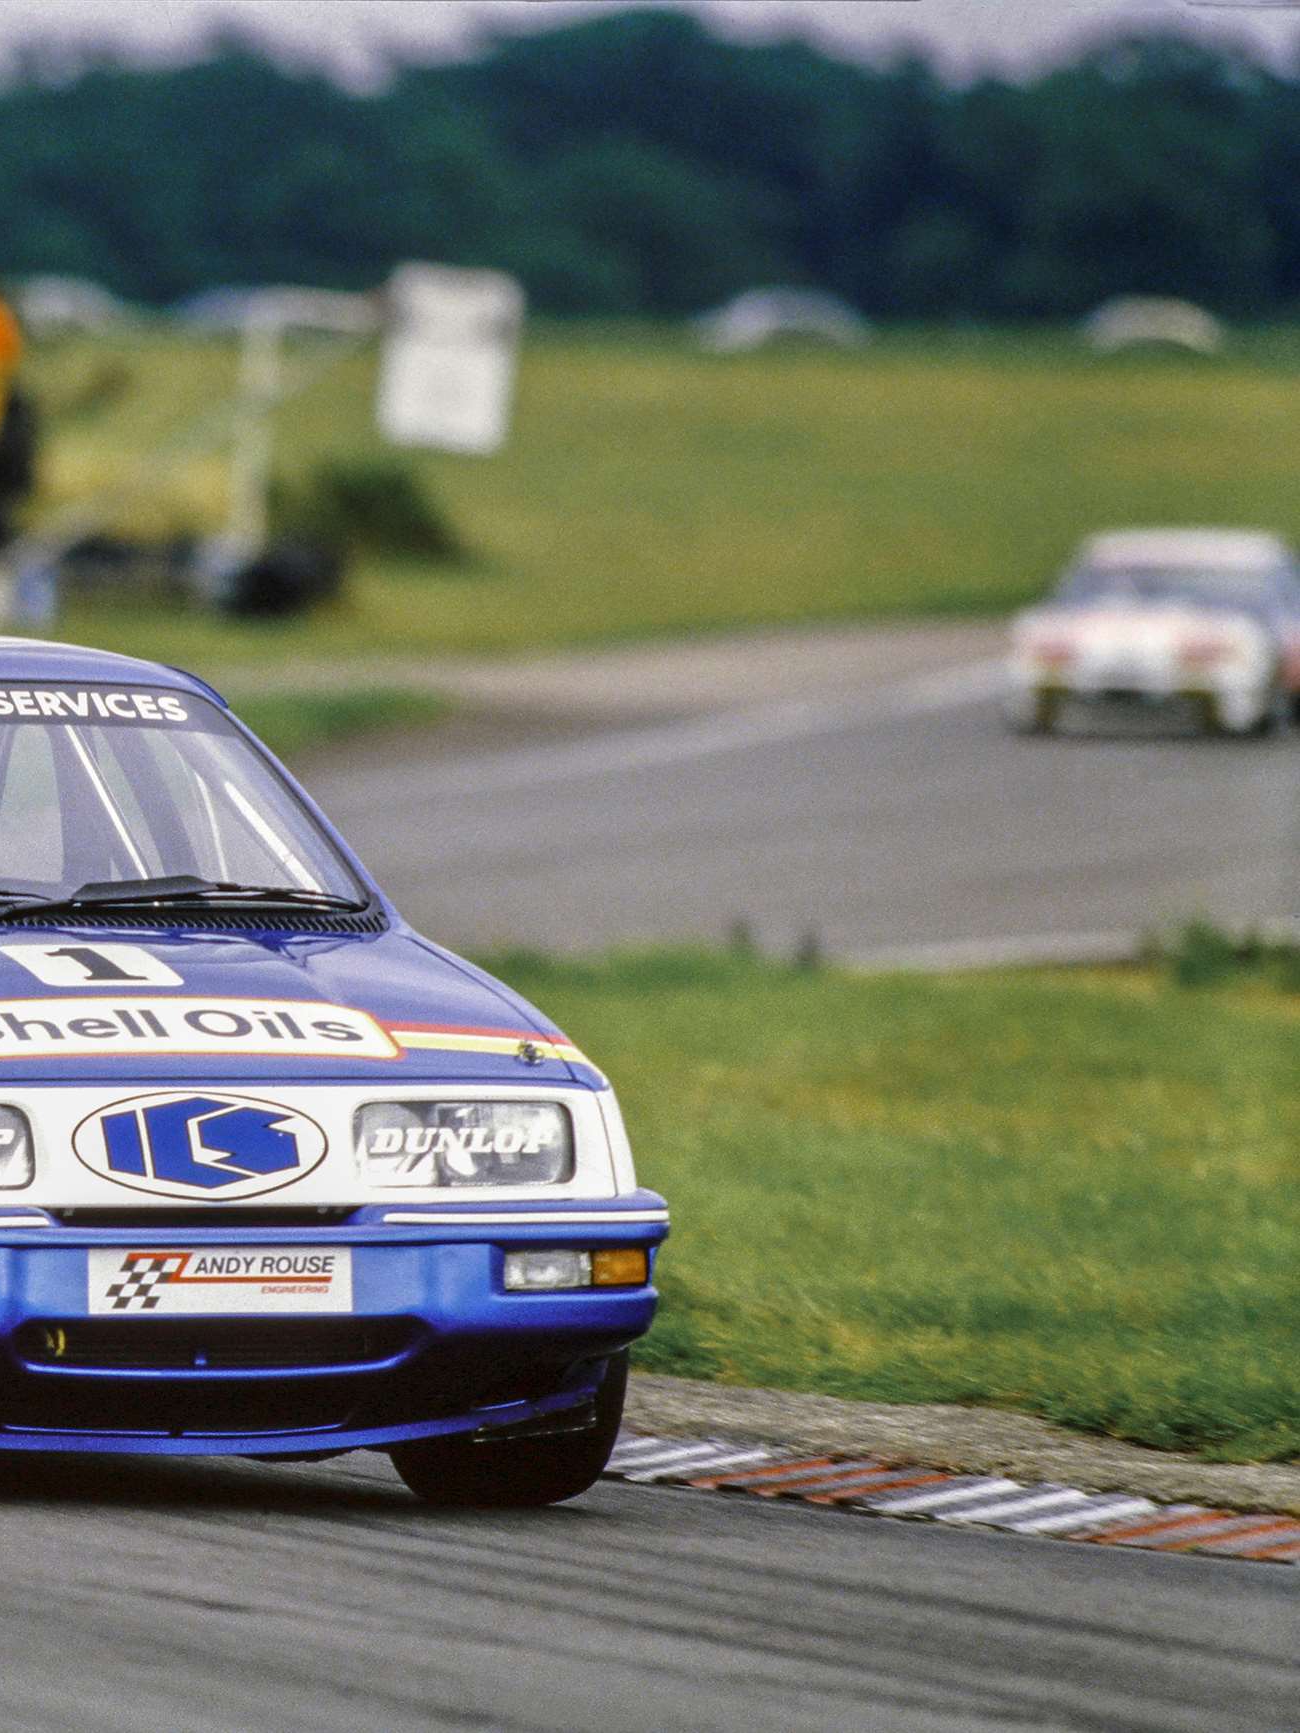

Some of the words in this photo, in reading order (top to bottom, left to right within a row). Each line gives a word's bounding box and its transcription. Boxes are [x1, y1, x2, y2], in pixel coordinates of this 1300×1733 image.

[44, 947, 149, 981] 1
[184, 1009, 363, 1042] Oils
[369, 1127, 555, 1153] DUNLOP
[193, 1257, 256, 1275] ANDY
[260, 1256, 336, 1274] ROUSE
[261, 1285, 329, 1295] ENGINEERING
